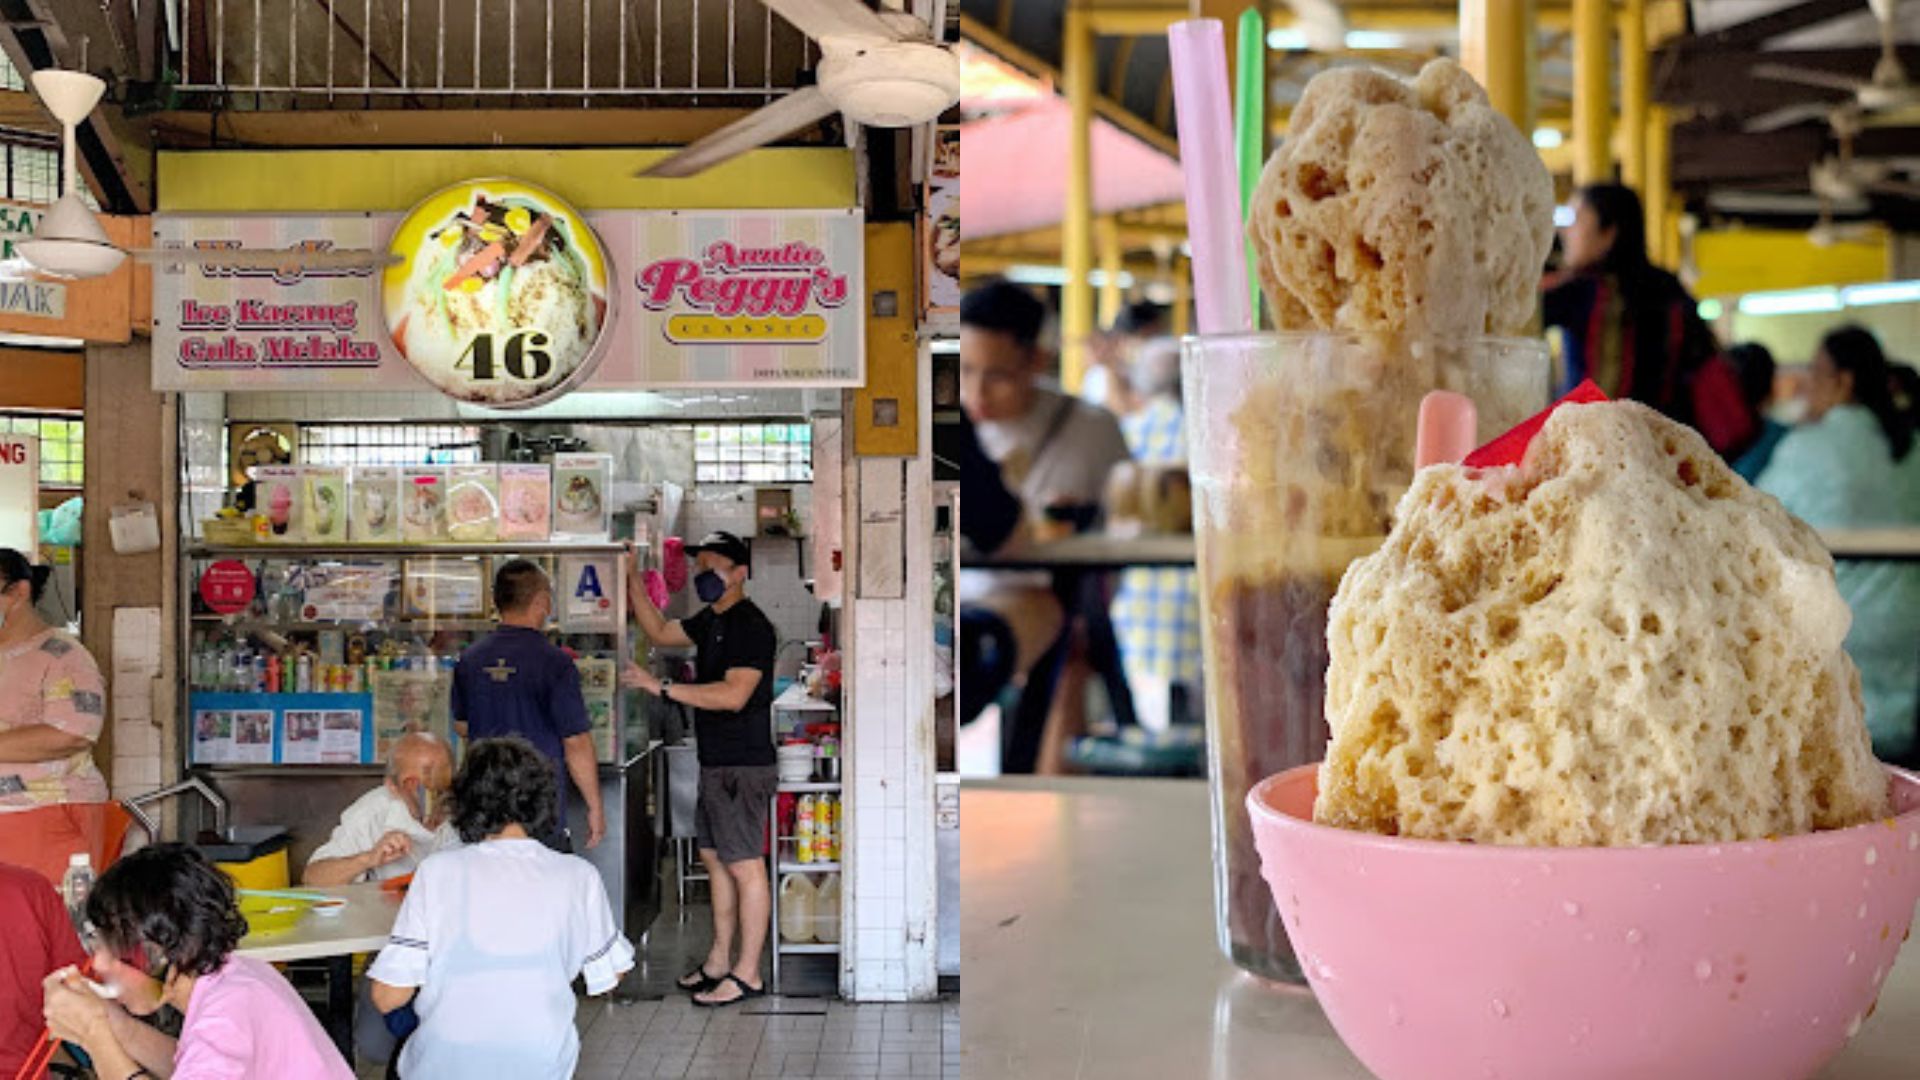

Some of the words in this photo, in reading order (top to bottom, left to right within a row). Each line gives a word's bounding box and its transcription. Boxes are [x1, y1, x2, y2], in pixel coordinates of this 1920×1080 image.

[703, 241, 824, 268] Auntie
[639, 258, 848, 316] Peggy's
[183, 300, 230, 324] Ice
[236, 300, 358, 329] Karang
[180, 336, 256, 362] Gula
[262, 336, 380, 362] Melaka
[454, 331, 551, 380] 46
[575, 565, 602, 597] A
